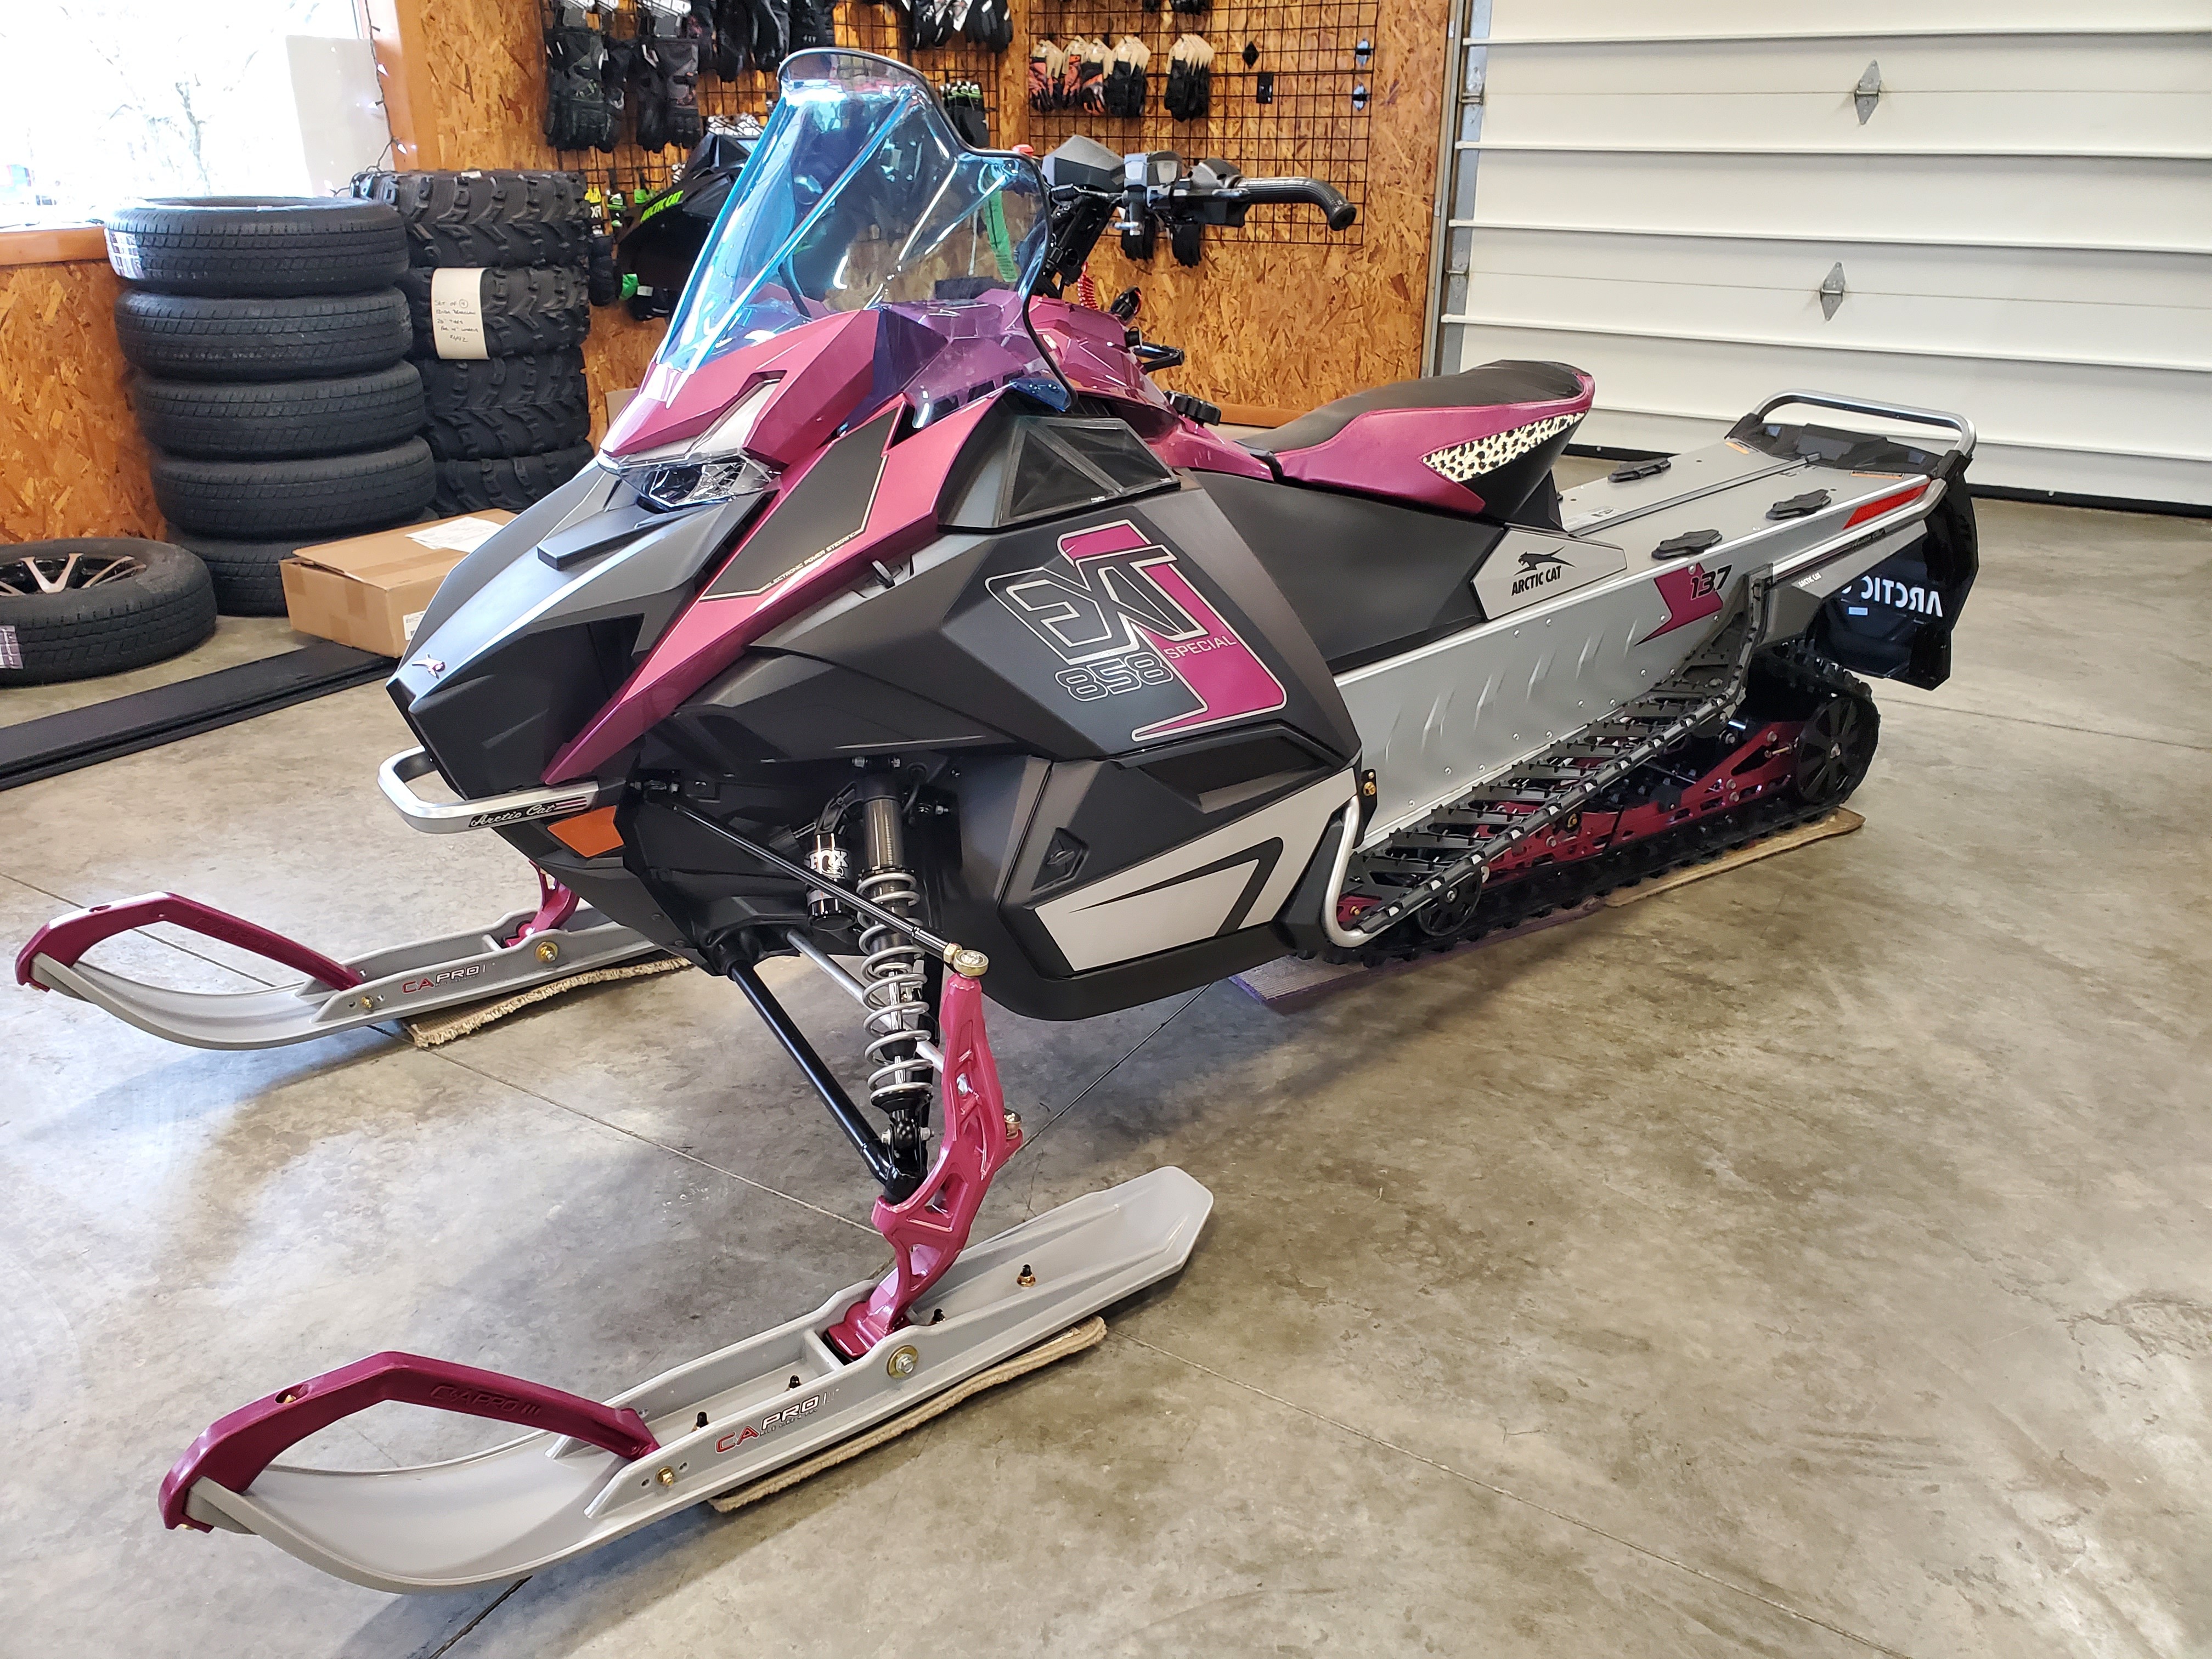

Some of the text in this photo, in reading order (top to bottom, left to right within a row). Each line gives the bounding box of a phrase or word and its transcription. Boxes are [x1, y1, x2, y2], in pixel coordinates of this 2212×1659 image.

[665, 190, 684, 207] CAT
[804, 550, 826, 566] POWER
[1511, 565, 1562, 596] ARCTIC CAT
[1690, 563, 1733, 601] 137
[1163, 635, 1237, 660] SPECIAL
[1054, 652, 1173, 702] 858
[471, 804, 556, 826] Arctic Cat
[809, 850, 849, 876] FOX
